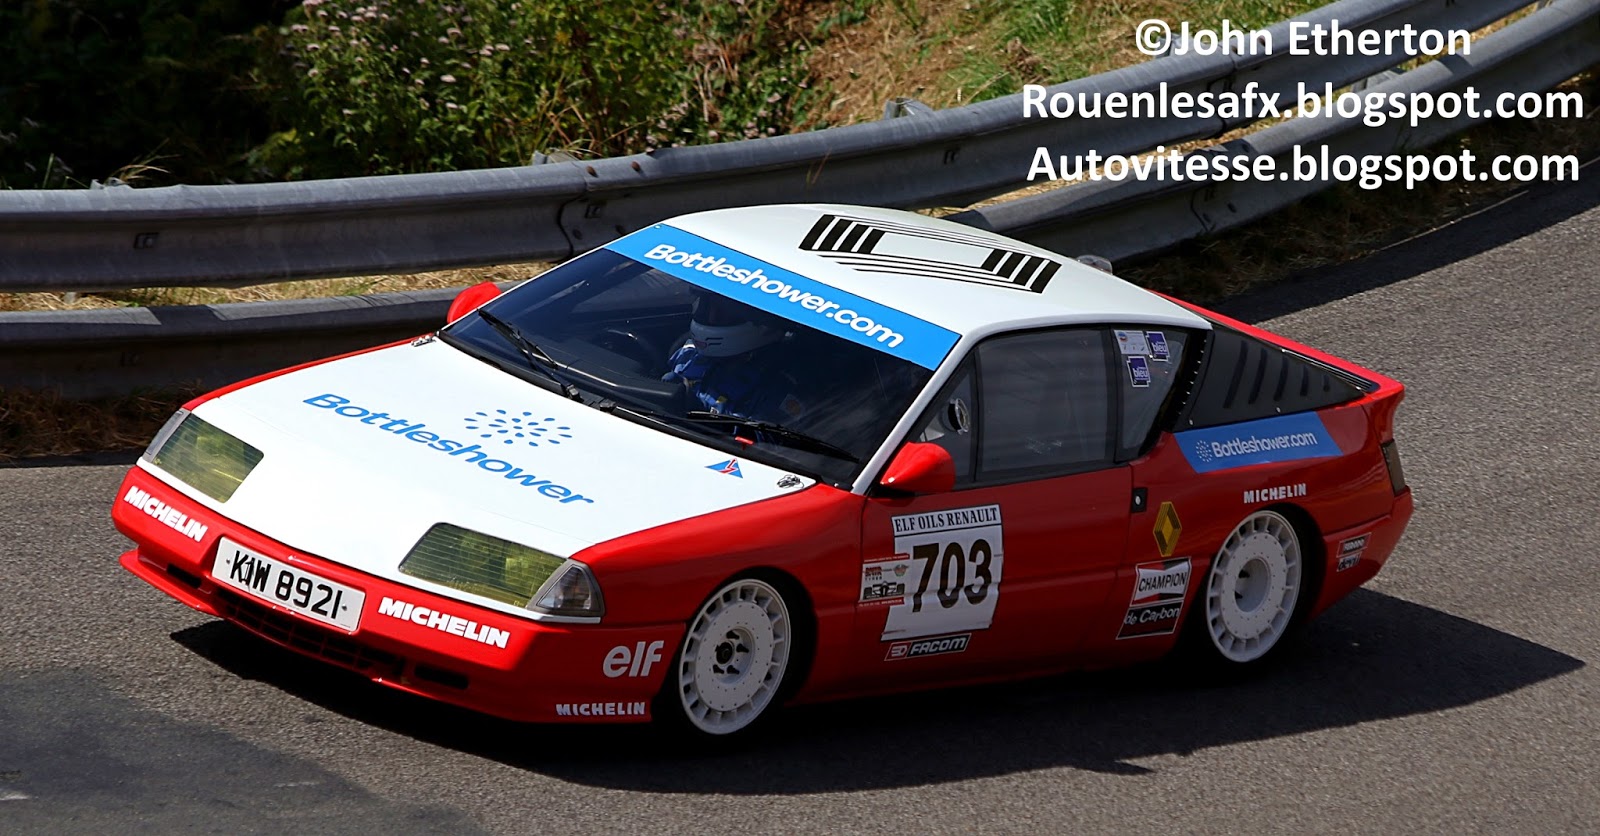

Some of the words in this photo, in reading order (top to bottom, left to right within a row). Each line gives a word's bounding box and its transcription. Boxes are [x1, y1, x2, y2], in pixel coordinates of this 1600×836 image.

[644, 243, 904, 349] Bottleshower.com
[302, 393, 595, 505] Bottleshower
[1211, 432, 1318, 458] Bottleshower.com
[1243, 483, 1307, 504] MICHELIN
[123, 485, 208, 542] MICHELIN
[894, 517, 916, 533] ELF
[918, 513, 945, 530] OILS
[946, 507, 998, 526] RENAULT
[912, 538, 992, 613] 703
[1138, 572, 1187, 592] CHAMPION
[275, 569, 343, 620] 8921
[378, 596, 510, 649] MICHELIN
[1124, 613, 1138, 625] de
[1139, 607, 1180, 623] Carbon
[603, 640, 664, 678] elf
[910, 637, 967, 655] FACOM
[555, 701, 646, 716] MICHELIN
